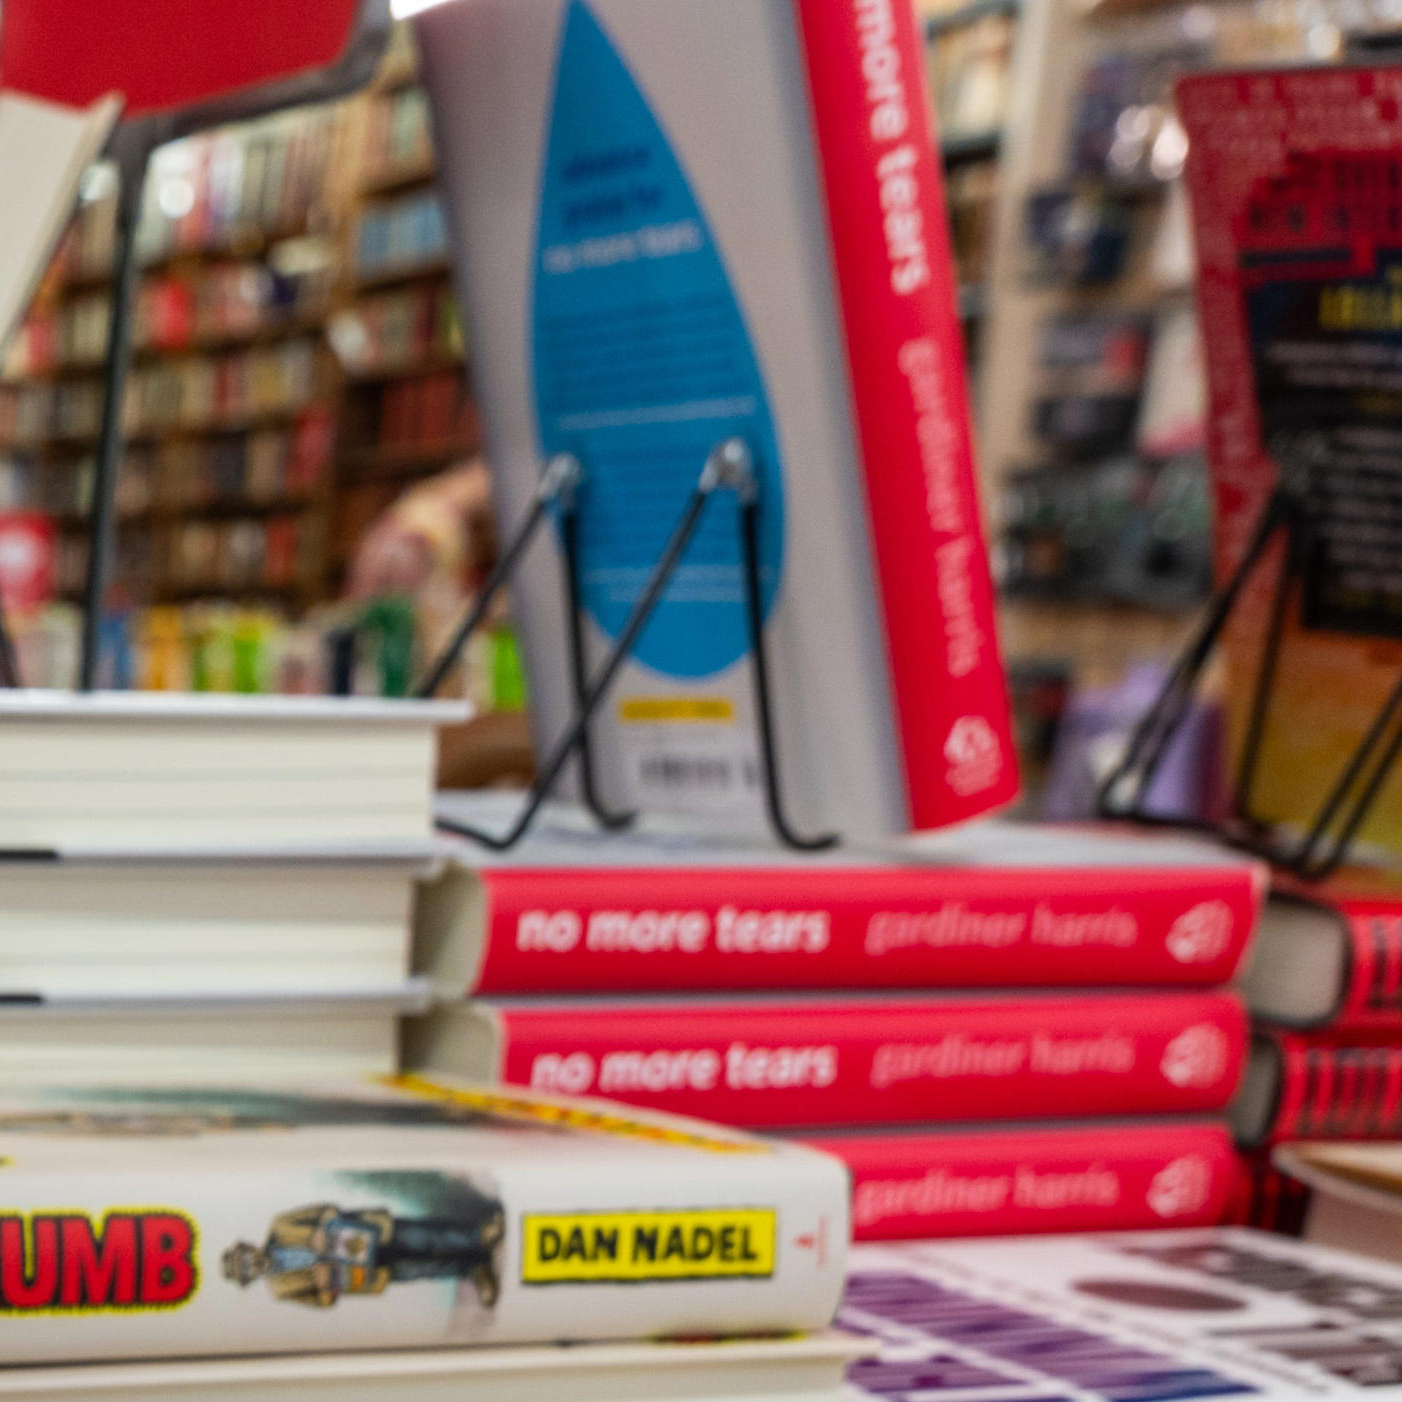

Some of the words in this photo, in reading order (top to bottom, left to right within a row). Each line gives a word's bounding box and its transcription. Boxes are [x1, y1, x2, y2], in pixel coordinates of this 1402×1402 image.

[876, 146, 931, 296] tears
[933, 534, 983, 678] harris
[518, 910, 576, 951] no
[588, 908, 706, 951] more
[716, 904, 830, 951] tears
[866, 902, 1021, 953] gardiner
[1030, 902, 1136, 947] harris
[532, 1052, 592, 1092] no
[601, 1048, 714, 1090] more
[725, 1042, 836, 1088] tears
[871, 1036, 1024, 1086] gardiner
[1032, 1031, 1133, 1074] harris
[1013, 1161, 1118, 1210] harris
[537, 1222, 622, 1265] DAN
[631, 1217, 762, 1263] NADEL
